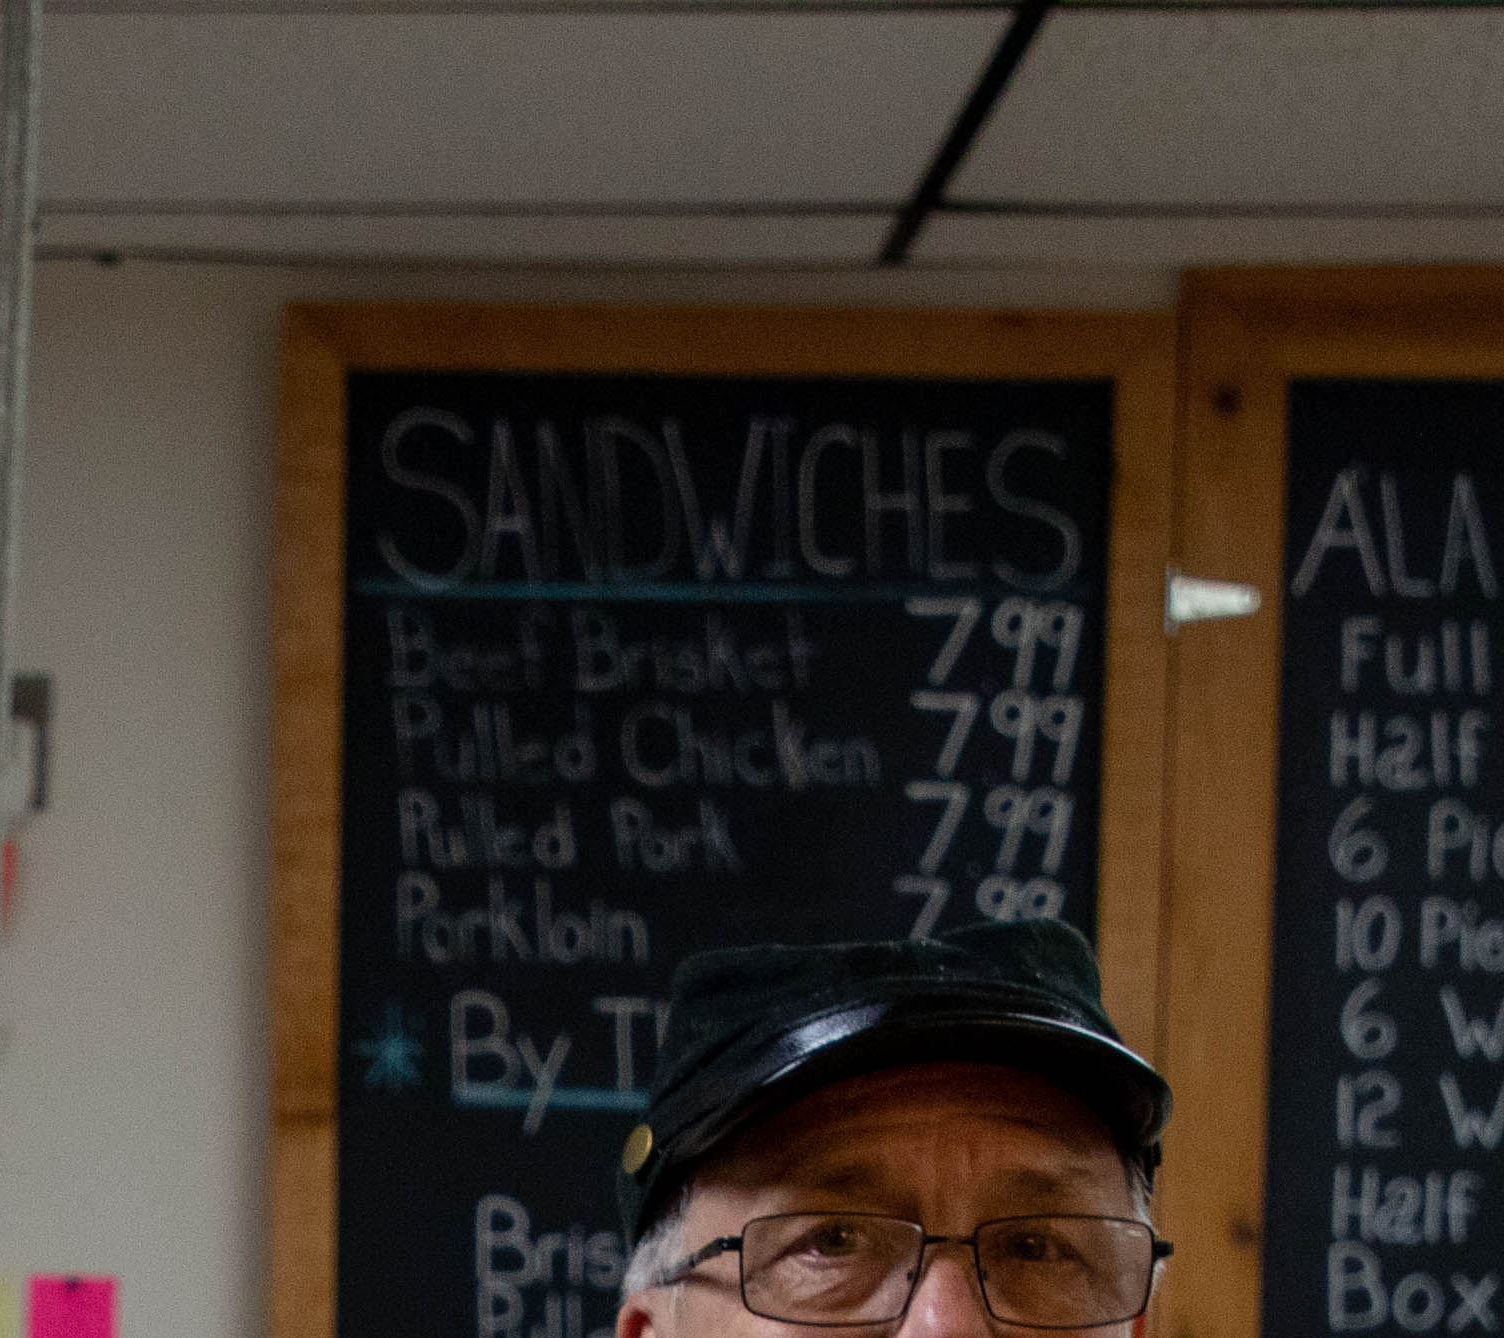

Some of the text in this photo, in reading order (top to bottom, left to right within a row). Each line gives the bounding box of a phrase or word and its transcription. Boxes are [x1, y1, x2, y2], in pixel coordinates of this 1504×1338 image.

[377, 405, 1083, 592] SANDWICHES
[571, 608, 820, 696] Brisket
[1337, 613, 1492, 698] Full
[388, 697, 598, 784] Pulled
[616, 700, 881, 791] Chicken
[1327, 708, 1489, 790] Half
[396, 787, 578, 870] Pulled
[1326, 797, 1391, 884] 6
[1334, 895, 1398, 972] 10
[1339, 977, 1398, 1060] 6
[448, 987, 573, 1138] By
[1335, 1069, 1403, 1150] 12
[473, 1190, 628, 1287] Bris
[1327, 1166, 1485, 1246] Half
